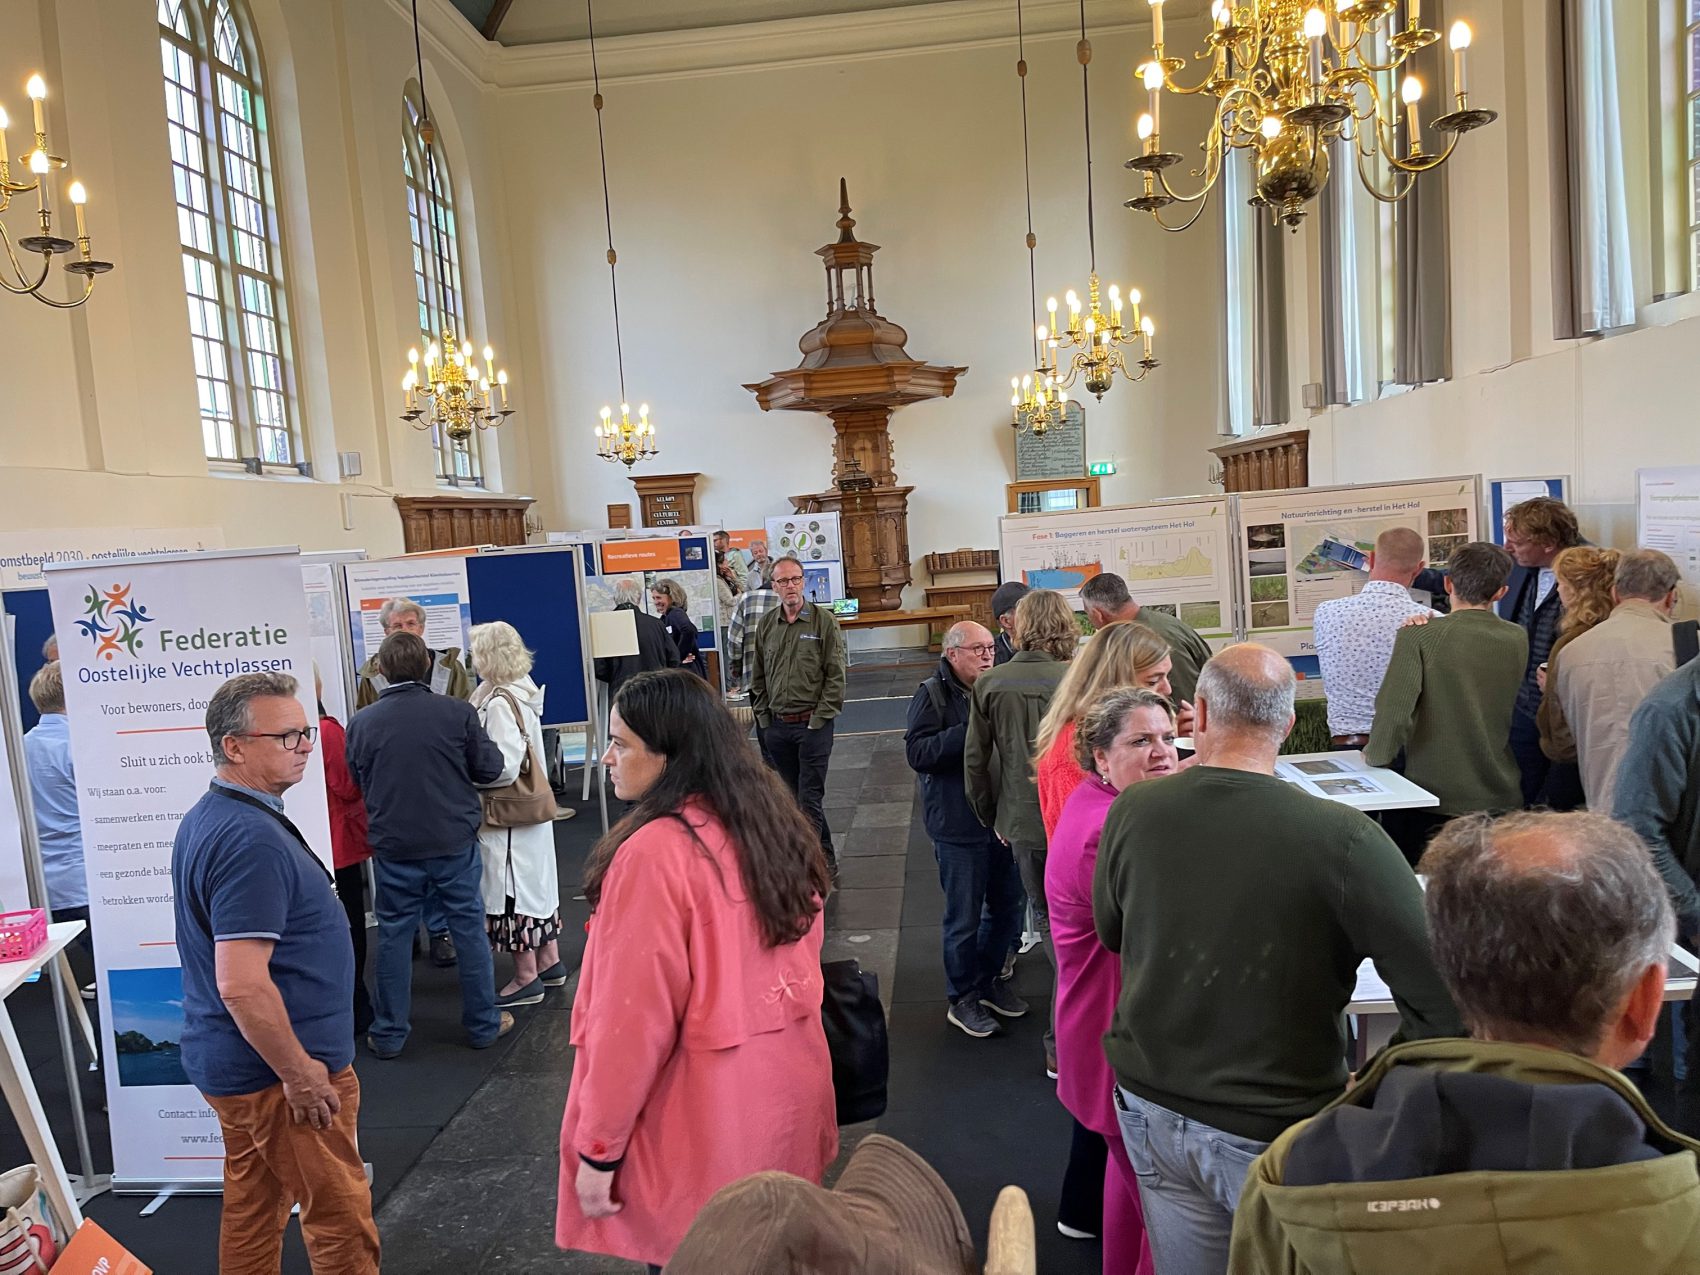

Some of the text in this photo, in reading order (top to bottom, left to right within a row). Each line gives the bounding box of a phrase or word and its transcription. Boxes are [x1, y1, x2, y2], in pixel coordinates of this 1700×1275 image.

[1281, 510, 1342, 519] Natuurinrichting
[1392, 502, 1406, 510] Het
[0, 550, 54, 568] omstbeeld
[160, 623, 288, 652] Federatie
[78, 658, 292, 684] Oostelijke Vechtplassen
[101, 698, 211, 715] Voor bewoners, doo
[120, 756, 147, 768] Sluit
[149, 758, 156, 766] u
[158, 753, 181, 766] zich
[183, 752, 203, 764] ook
[87, 787, 101, 799] Wij
[102, 788, 125, 796] staan
[126, 786, 142, 795] o.a.
[94, 813, 154, 824] samenwerken
[155, 813, 165, 821] en
[97, 842, 142, 853] meepraten
[156, 839, 176, 848] mee
[99, 870, 114, 878] een
[115, 867, 152, 880] gezonde
[101, 895, 145, 906] betrokken
